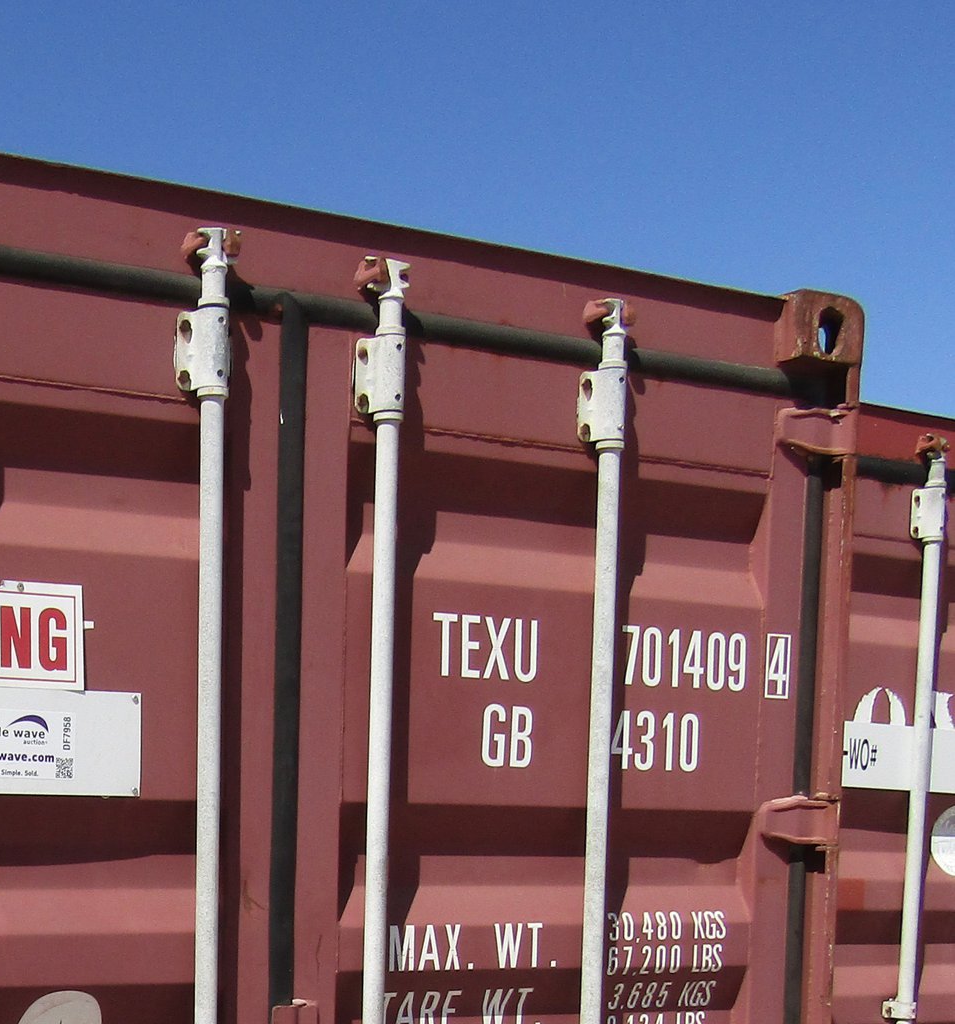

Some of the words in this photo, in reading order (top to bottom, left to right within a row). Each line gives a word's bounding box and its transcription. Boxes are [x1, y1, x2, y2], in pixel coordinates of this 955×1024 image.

[432, 612, 539, 682] TEXU
[622, 625, 747, 692] 701409
[768, 638, 786, 695] 4
[13, 730, 46, 740] wave
[62, 717, 72, 750] DF7958
[481, 703, 533, 768] GB
[610, 710, 699, 772] 4310
[1, 769, 23, 777] Simple.
[24, 769, 39, 777] Sold.
[691, 911, 726, 939] KGS
[388, 924, 474, 972] MAX.
[494, 922, 557, 969] WT.
[691, 944, 723, 973] LBS
[678, 980, 717, 1007] KGS
